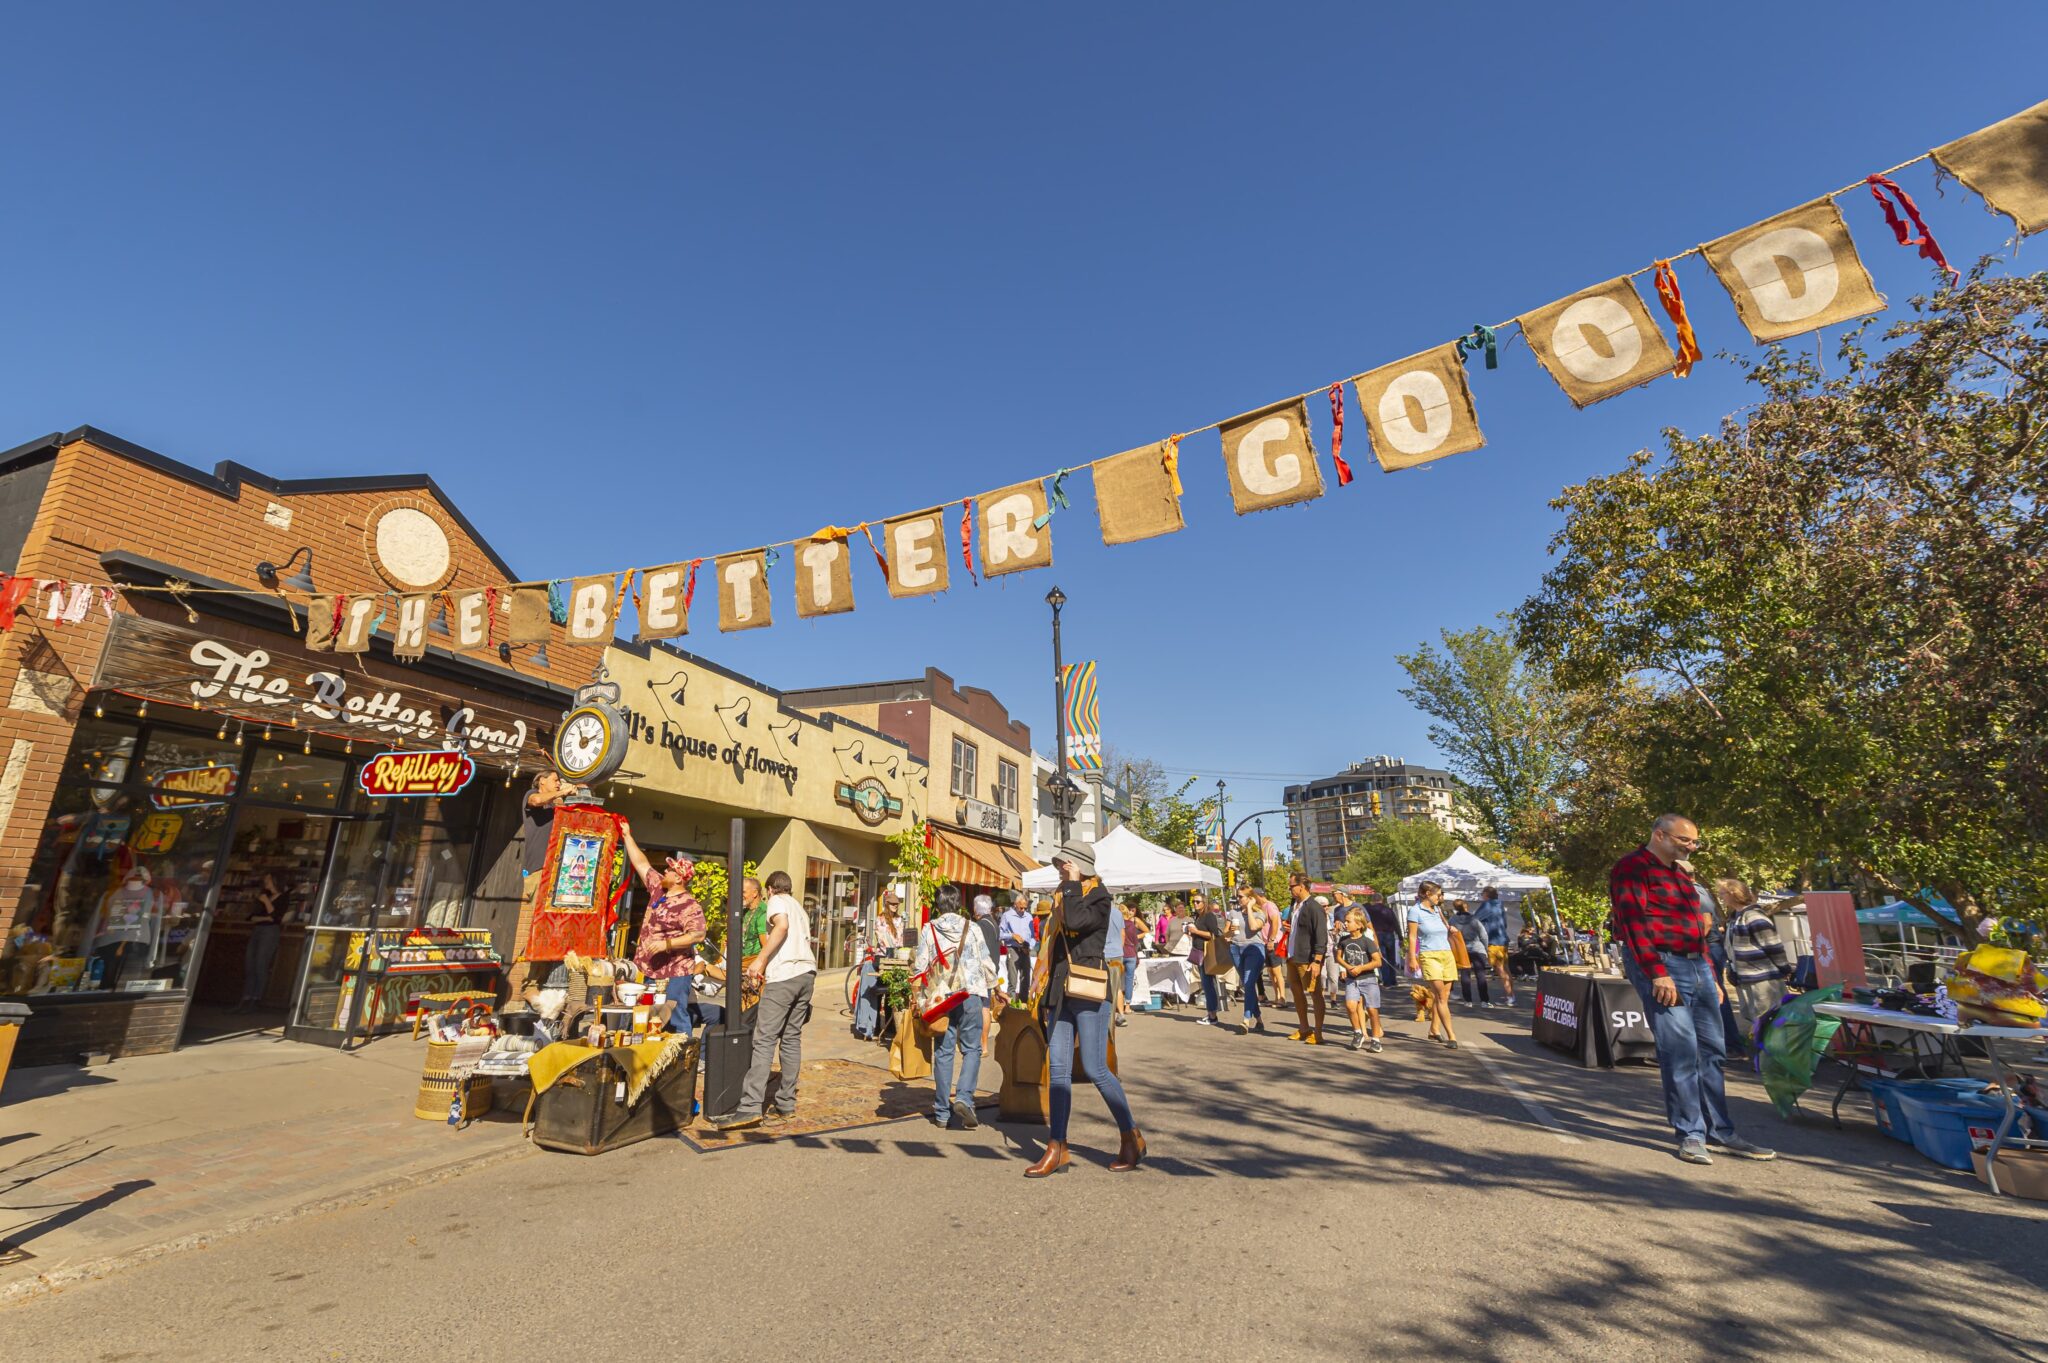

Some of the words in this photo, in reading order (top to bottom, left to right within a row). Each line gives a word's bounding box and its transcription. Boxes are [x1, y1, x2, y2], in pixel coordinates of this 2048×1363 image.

[348, 593, 483, 647] THE
[572, 493, 1039, 639] BETTER
[1237, 227, 1840, 495] GOOD
[190, 640, 292, 704] The
[302, 671, 438, 739] Better
[442, 708, 527, 754] Good
[374, 754, 461, 793] Refillery
[660, 721, 717, 760] house
[722, 742, 742, 764] of
[745, 746, 798, 783] flowers
[1542, 1007, 1558, 1022] PUBLIC
[1543, 994, 1575, 1014] SASKATOON
